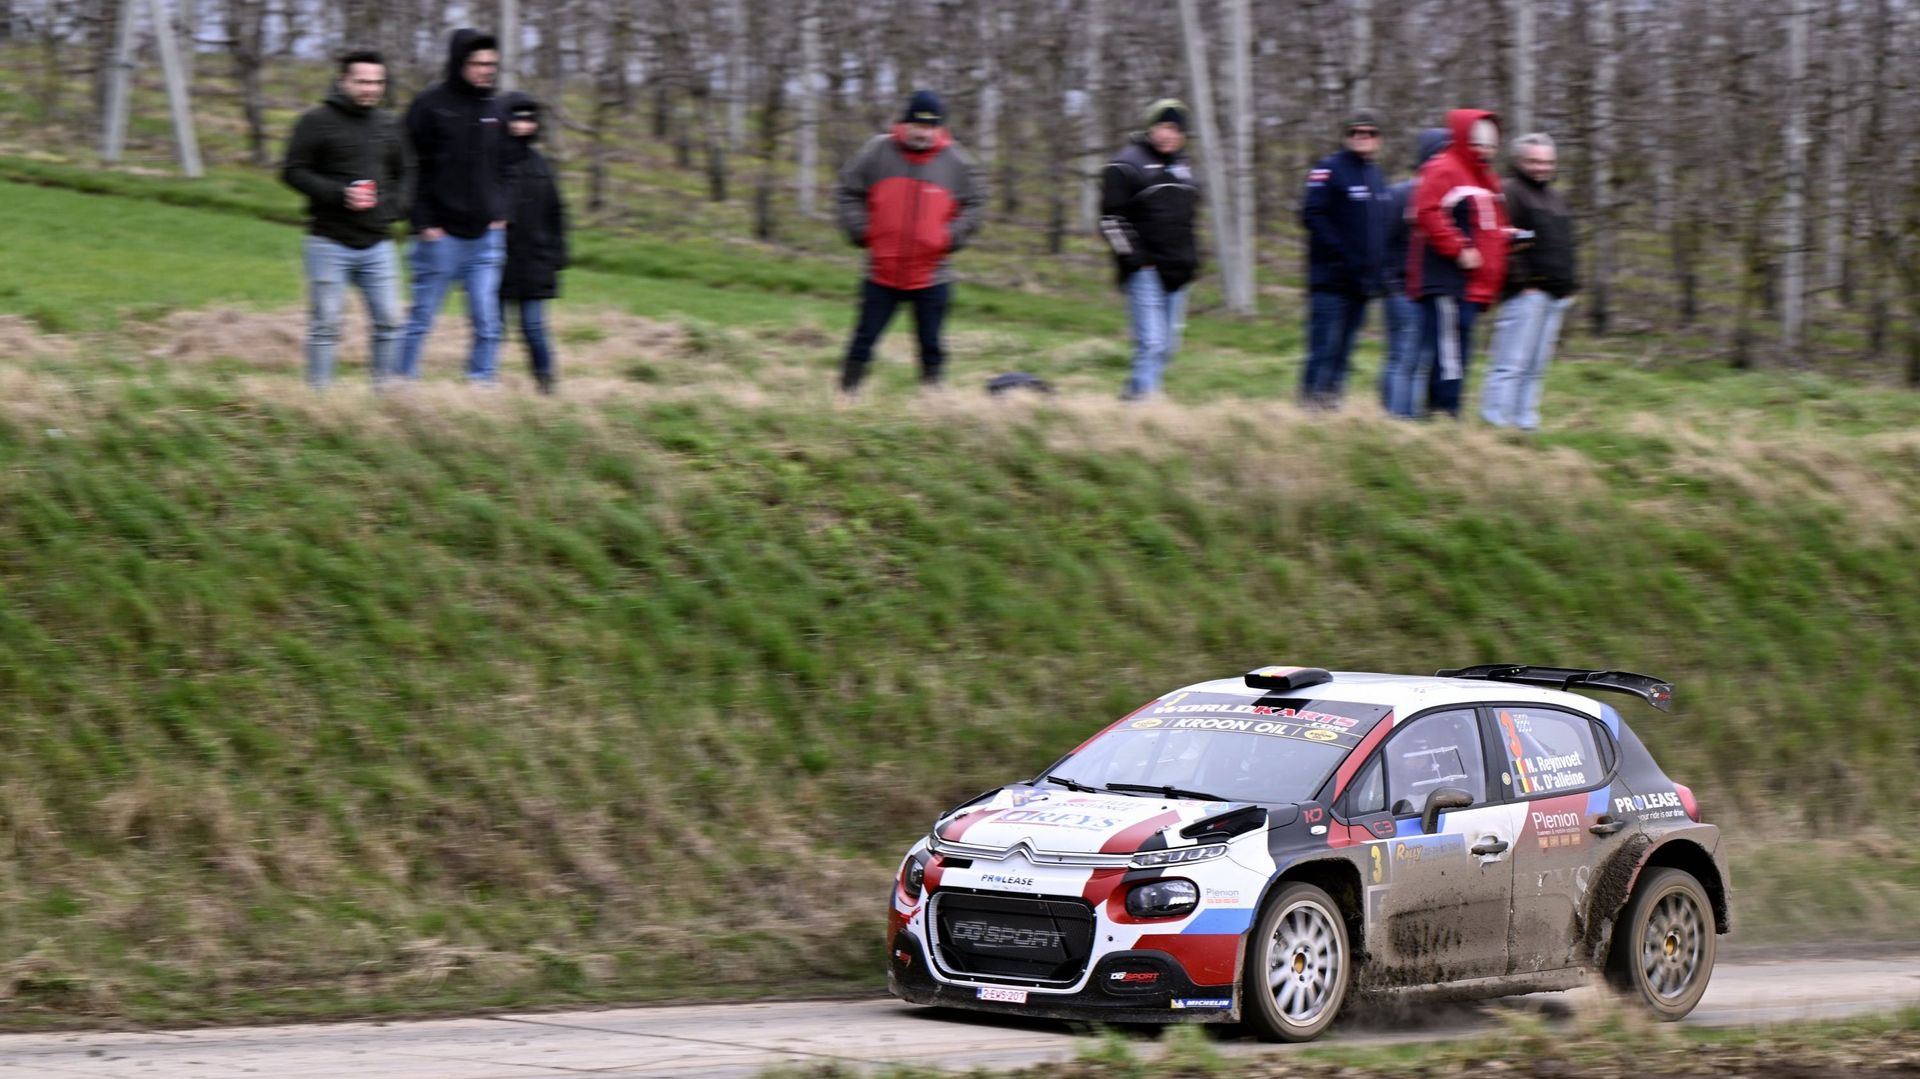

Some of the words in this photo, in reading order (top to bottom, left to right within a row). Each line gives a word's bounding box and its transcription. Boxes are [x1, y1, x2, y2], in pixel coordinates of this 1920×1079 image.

[1153, 704, 1359, 727] WORLDKARTS
[1173, 719, 1253, 731] KROON
[1254, 722, 1288, 735] OIL
[1500, 711, 1523, 758] 3
[1524, 757, 1538, 774] N.
[1536, 751, 1583, 772] Reynvoet
[1530, 775, 1544, 792] K.
[1542, 771, 1586, 790] D'alleine
[1614, 792, 1681, 813] PROLEASE
[1373, 822, 1394, 834] C3
[1532, 809, 1580, 829] Plenion
[1370, 845, 1383, 883] 3
[981, 874, 1034, 886] PROLEASE
[1206, 888, 1240, 897] Plenion
